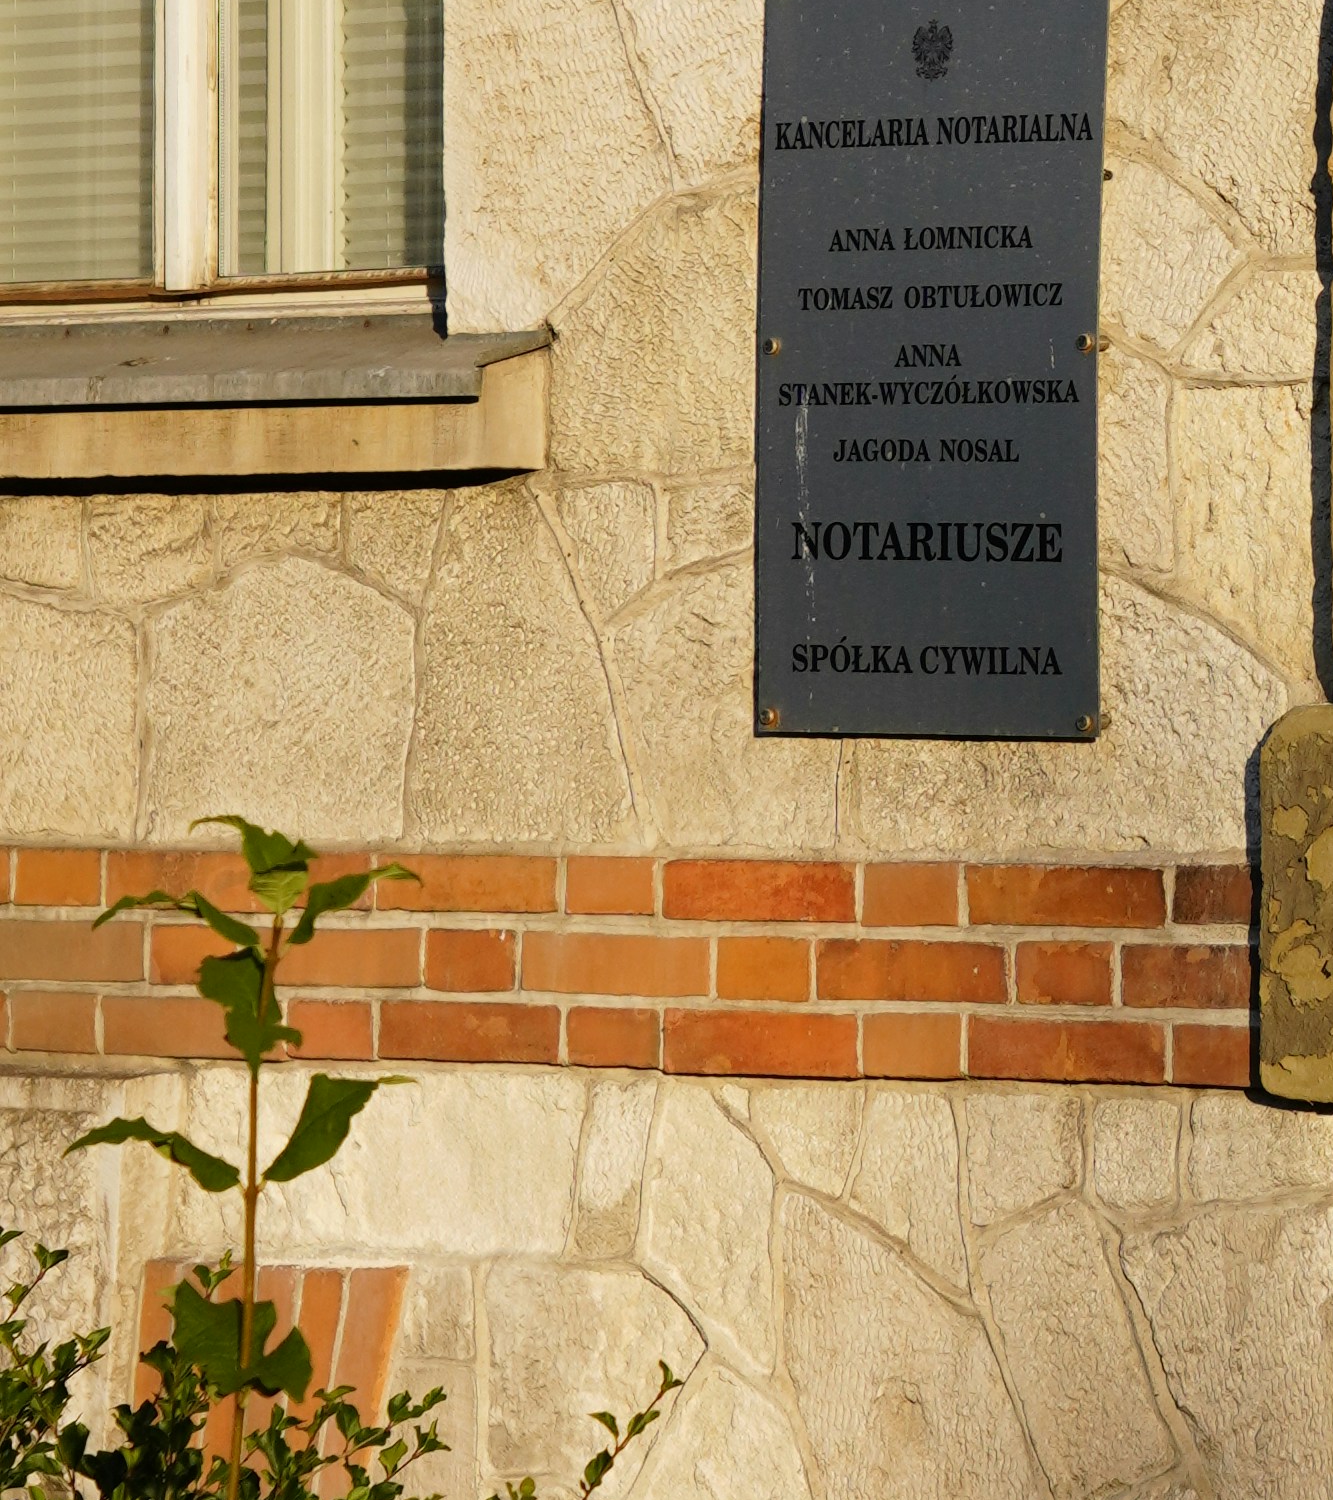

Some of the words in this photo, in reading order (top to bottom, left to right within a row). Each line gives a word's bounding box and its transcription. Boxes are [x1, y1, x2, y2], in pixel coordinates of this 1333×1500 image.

[775, 116, 929, 150] KANCELARIA
[936, 112, 1094, 145] NOTARIALNA
[828, 227, 896, 252] ANNA
[903, 225, 1034, 251] ŁOMNICKA
[798, 286, 894, 311] TOMASZ
[904, 283, 1064, 309] OBTUŁOWICZ
[894, 344, 962, 368] ANNA
[778, 375, 1080, 406] STANEK-WYCZÓŁKOWSKA
[833, 438, 931, 463] JAGODA
[939, 438, 1020, 463] NOSAL
[791, 521, 1063, 563] NOTARIUSZE
[791, 636, 913, 674] SPÓŁKA
[919, 645, 1063, 675] CYWILNA
